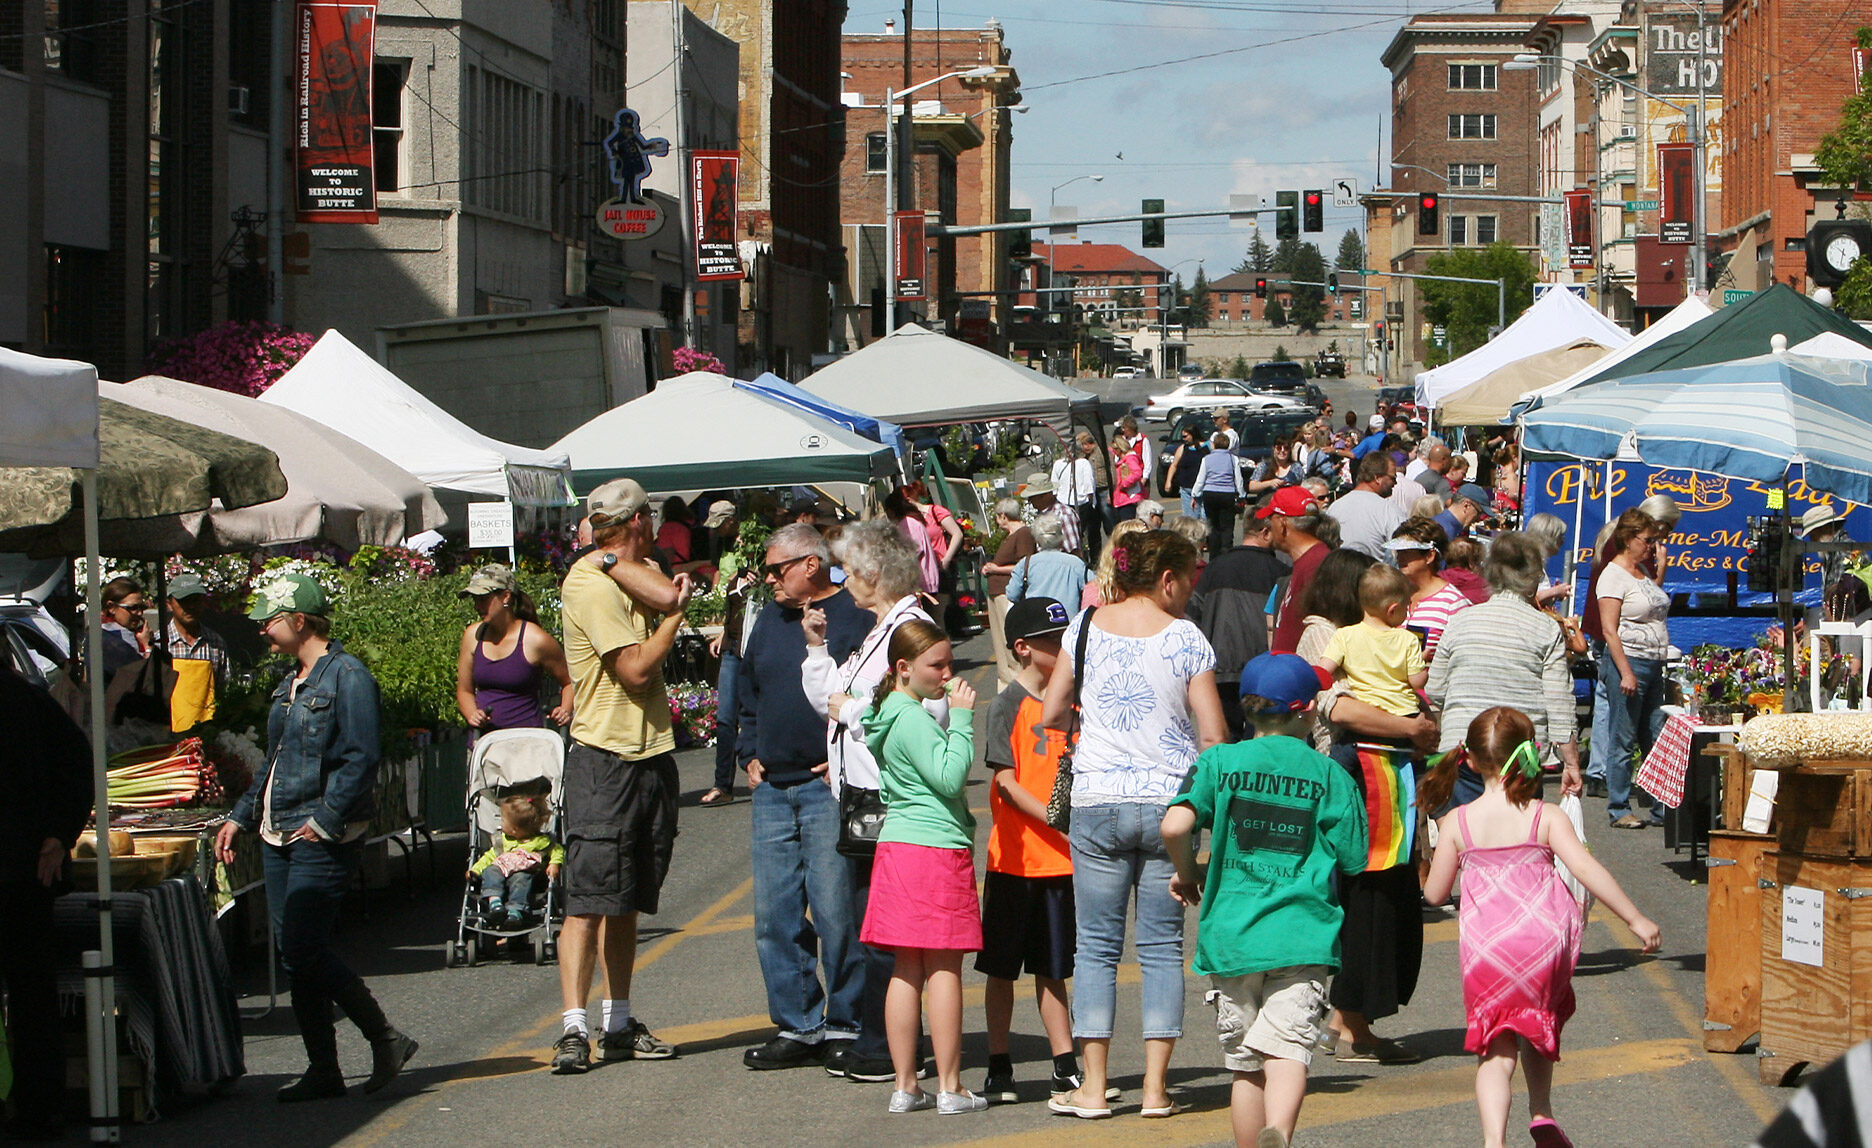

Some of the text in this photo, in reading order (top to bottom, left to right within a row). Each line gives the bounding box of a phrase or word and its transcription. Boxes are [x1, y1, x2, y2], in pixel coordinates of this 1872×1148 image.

[1652, 24, 1700, 50] The
[300, 9, 312, 148] Rich in Railroad History
[1678, 58, 1723, 88] HO
[308, 188, 363, 196] HISTORIC
[318, 199, 355, 207] BUTTE
[603, 209, 656, 222] JAIL HOUSE
[613, 222, 647, 233] COFFEE
[699, 257, 738, 265] HISTORIC
[706, 265, 735, 273] BUTTE
[1724, 293, 1750, 303] SOU
[1546, 462, 1627, 505] Pie
[470, 520, 512, 528] BASKETS
[1666, 550, 1717, 572] akes
[1722, 556, 1733, 570] &
[1243, 818, 1266, 830] GET
[1222, 858, 1254, 873] HIGH
